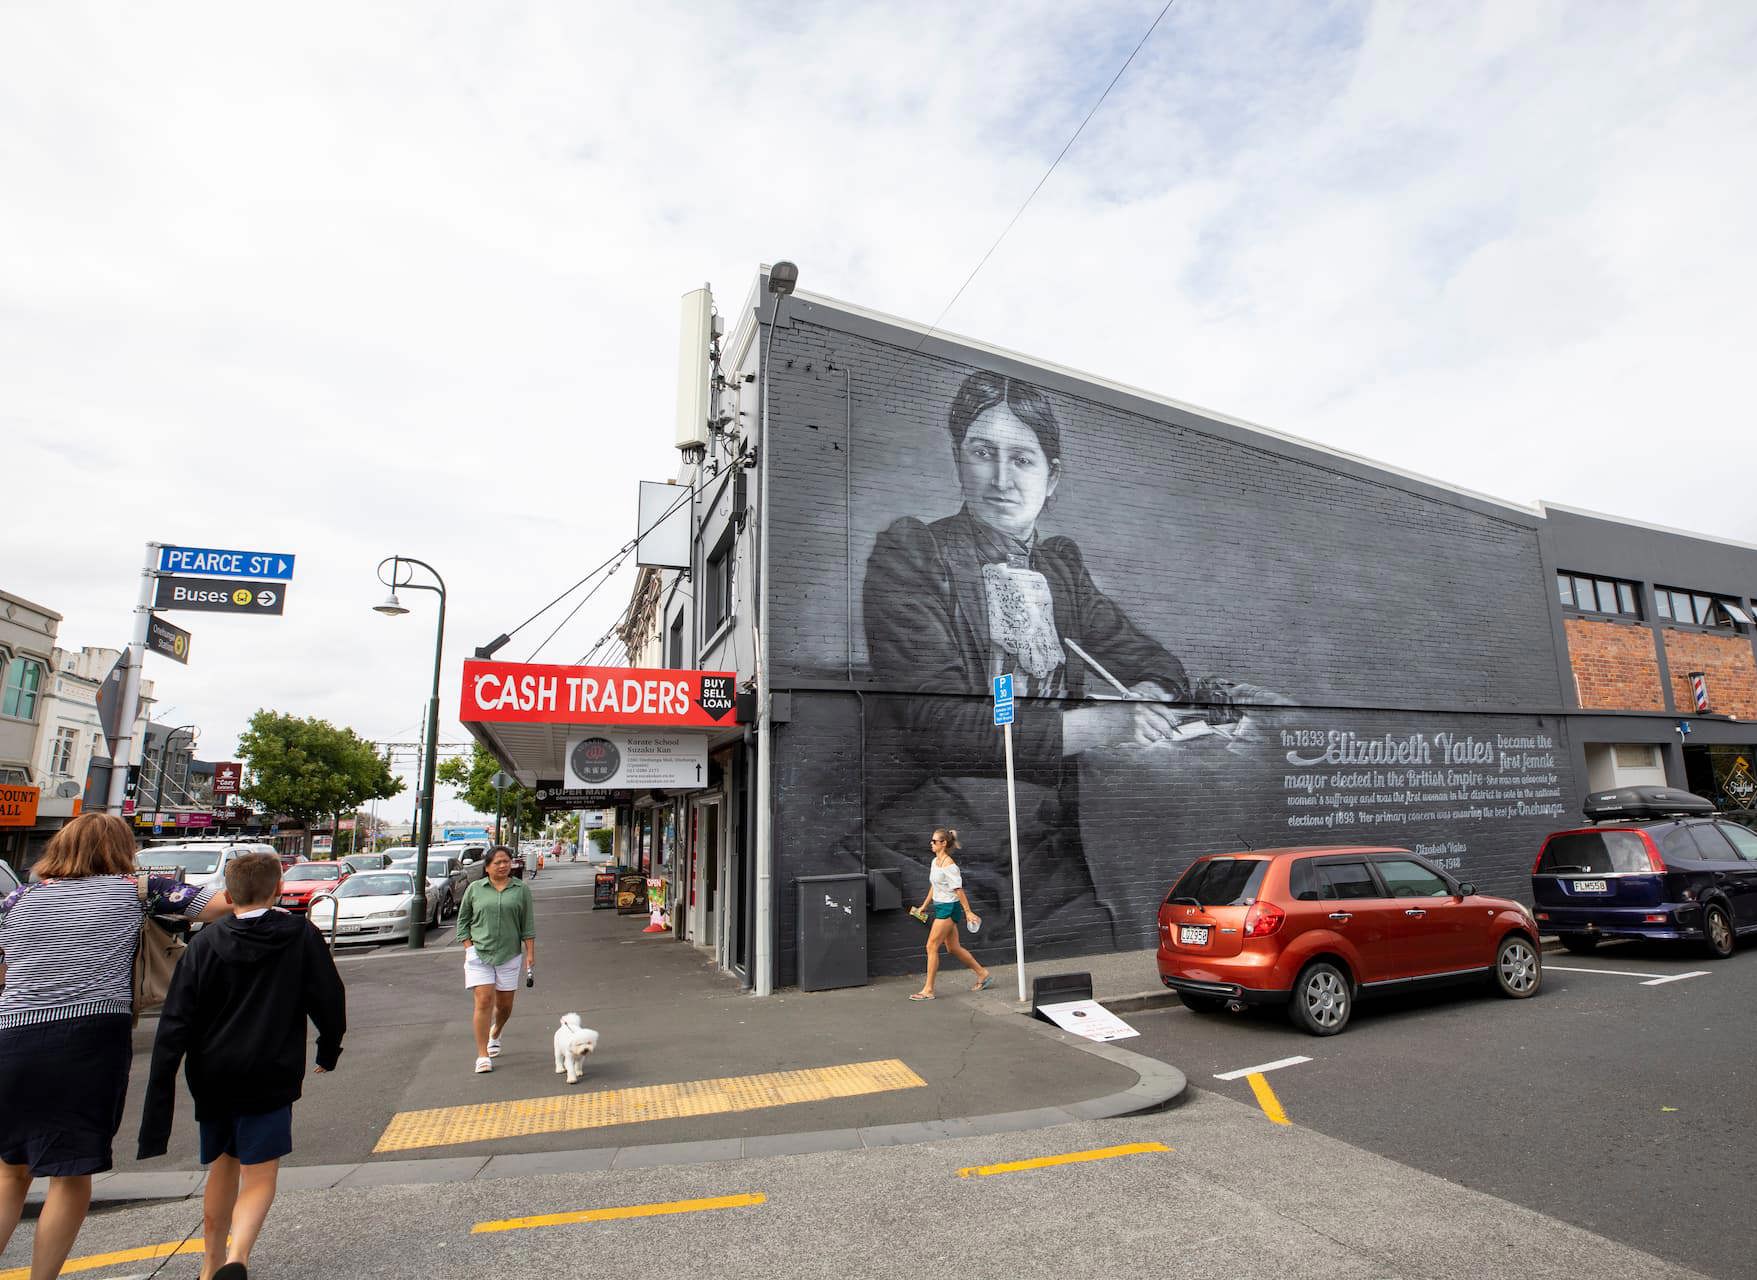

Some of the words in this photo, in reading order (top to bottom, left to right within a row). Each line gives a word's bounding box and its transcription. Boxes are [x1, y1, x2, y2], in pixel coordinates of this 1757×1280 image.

[168, 550, 243, 572] PEARCE
[249, 556, 273, 574] ST
[173, 586, 229, 603] Buses
[704, 678, 726, 689] BUY
[999, 677, 1007, 689] P
[474, 673, 558, 711] CASH
[566, 677, 690, 715] TRADERS
[703, 688, 727, 699] SELL
[702, 699, 732, 709] LOAN
[627, 738, 653, 746] Karate
[654, 738, 680, 746] School
[1280, 729, 1296, 747] In
[1296, 729, 1325, 747] 1893
[1497, 733, 1535, 749] became
[1536, 734, 1553, 749] the
[1286, 730, 1432, 766] Elizabeth
[1434, 732, 1495, 765] Yates
[1499, 751, 1520, 773] first
[1520, 752, 1554, 773] female
[1284, 774, 1328, 793] mayor
[1330, 771, 1372, 788] elected
[1373, 770, 1385, 788] in
[1387, 771, 1405, 787] the
[1406, 769, 1446, 787] British
[1447, 769, 1483, 792] Empire
[1547, 772, 1558, 785] for
[548, 788, 583, 796] SUPER
[585, 788, 612, 796] MART
[1287, 793, 1324, 806] women's
[1324, 792, 1358, 808] suffrage
[1359, 792, 1376, 804] and
[1376, 794, 1393, 803] was
[1393, 791, 1405, 803] the
[1404, 791, 1421, 806] first
[1422, 792, 1449, 801] woman
[1449, 791, 1457, 801] in
[1457, 789, 1469, 801] her
[1470, 789, 1495, 800] district
[1524, 788, 1534, 798] the
[1287, 814, 1324, 827] elections
[1325, 812, 1334, 828] of
[1335, 811, 1355, 825] 1893
[1358, 811, 1374, 823] Her
[1375, 810, 1407, 825] primary
[1408, 812, 1437, 821] concern
[1437, 811, 1451, 820] was
[1452, 806, 1483, 821] ensuring
[1483, 806, 1494, 818] the
[1494, 806, 1507, 817] best
[1507, 805, 1517, 819] for
[1517, 801, 1566, 818] Onehunga.
[1415, 843, 1447, 855] Elizabeth
[1447, 842, 1467, 854] Yates
[646, 879, 662, 887] OPEN
